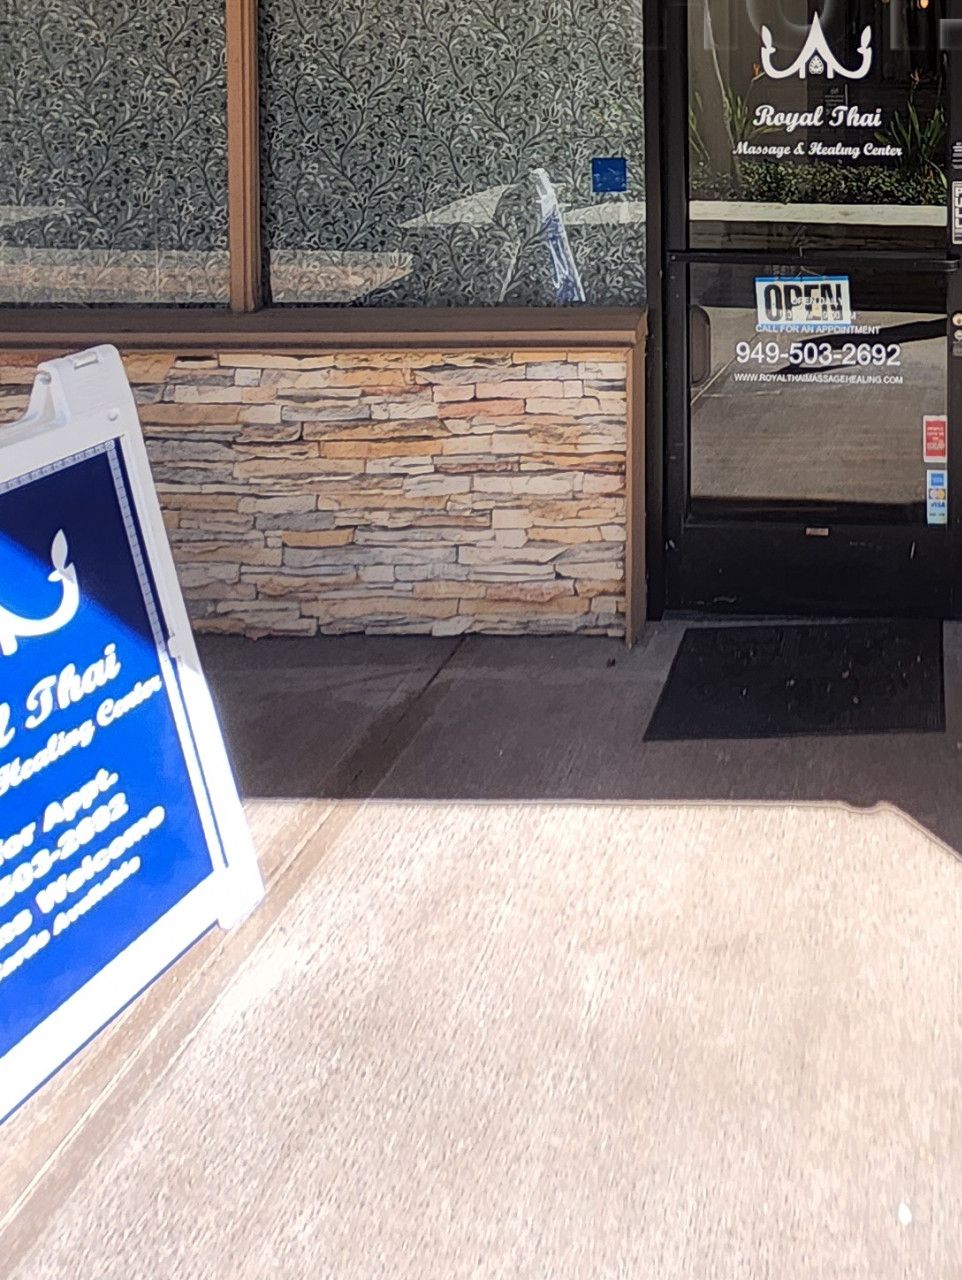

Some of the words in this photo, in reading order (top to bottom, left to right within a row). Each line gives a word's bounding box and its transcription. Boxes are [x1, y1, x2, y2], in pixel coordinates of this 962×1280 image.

[752, 104, 824, 133] Royal
[828, 105, 882, 127] Thai
[732, 141, 791, 159] Massage
[793, 141, 806, 156] &
[808, 142, 860, 159] Healing
[863, 142, 903, 156] Center
[763, 284, 843, 321] OPEN
[756, 324, 779, 334] CALL
[780, 324, 800, 334] FOR
[801, 324, 814, 334] AN
[815, 325, 880, 335] APPOINTMENT
[736, 341, 901, 366] 949-503-2692
[24, 642, 121, 729] Thai
[96, 675, 162, 726] Center
[35, 805, 165, 914] Welcome
